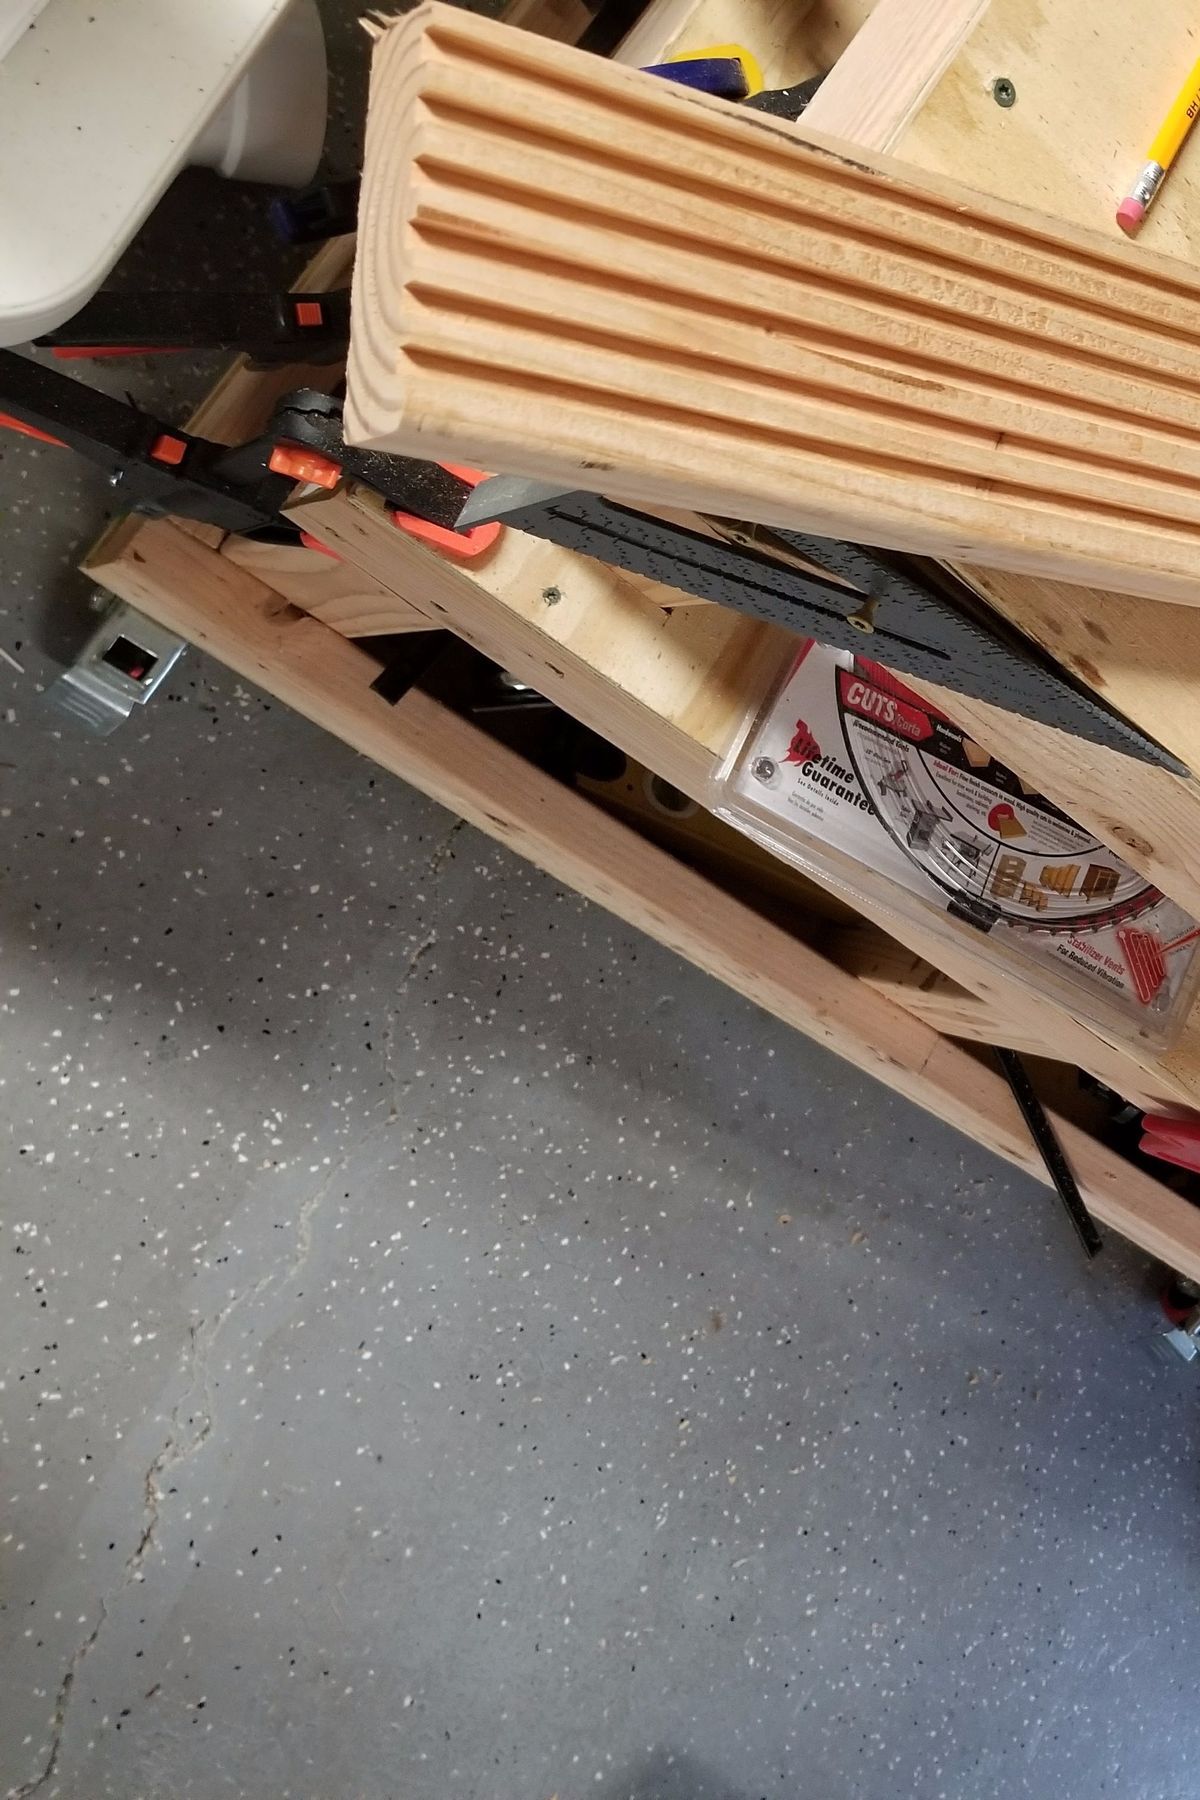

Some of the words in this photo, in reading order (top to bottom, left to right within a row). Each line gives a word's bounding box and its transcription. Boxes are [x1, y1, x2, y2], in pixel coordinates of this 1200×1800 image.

[847, 682, 898, 722] CUTS
[1056, 943, 1068, 956] For
[1068, 950, 1097, 974] Reduced
[1096, 966, 1126, 989] Vibration
